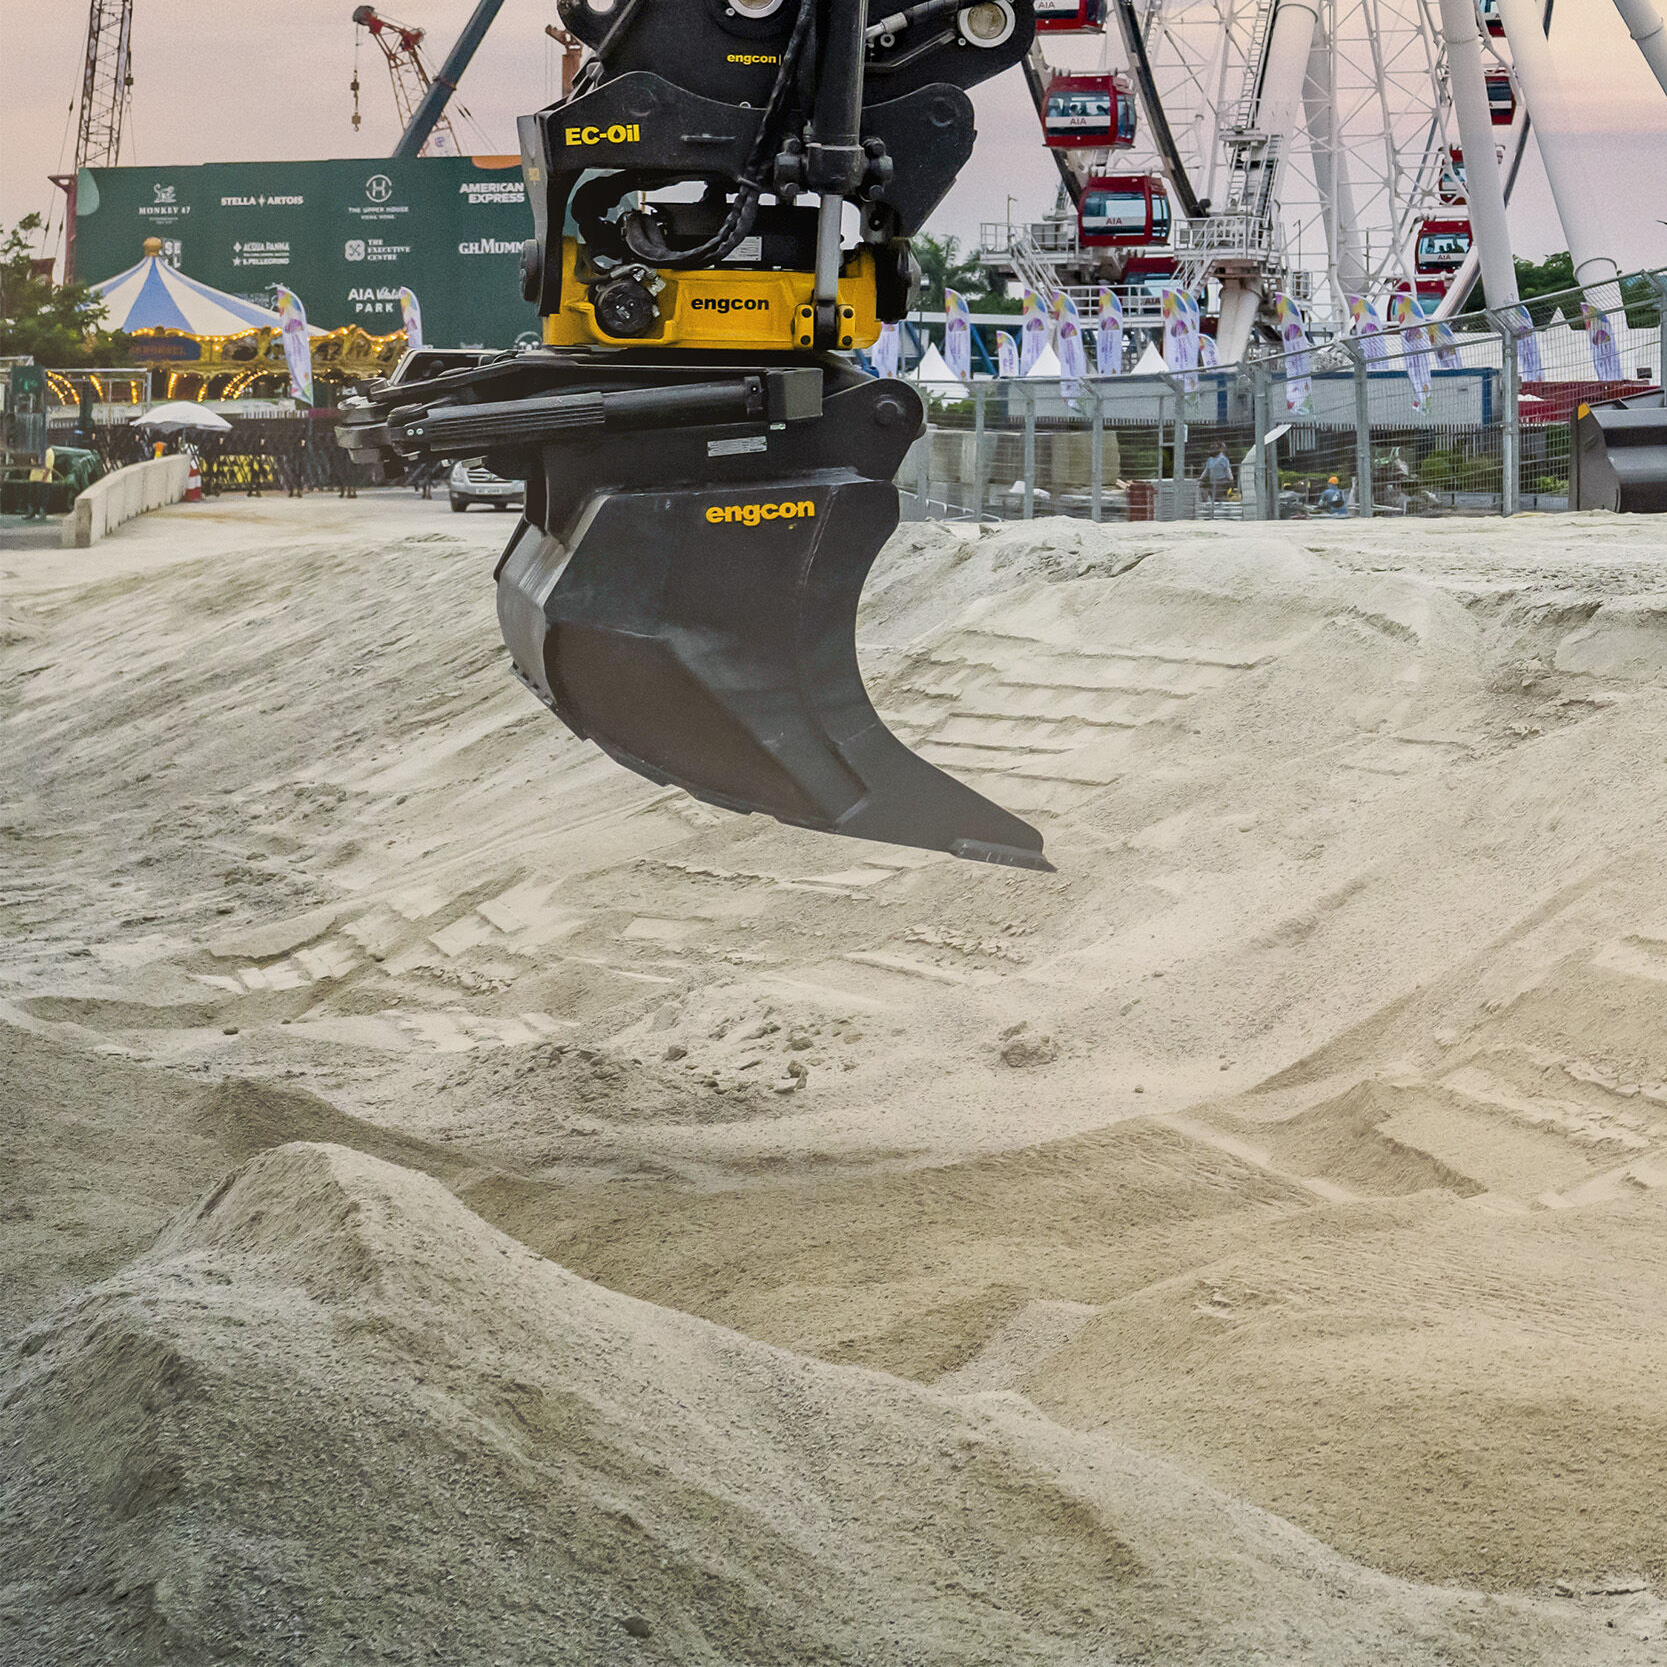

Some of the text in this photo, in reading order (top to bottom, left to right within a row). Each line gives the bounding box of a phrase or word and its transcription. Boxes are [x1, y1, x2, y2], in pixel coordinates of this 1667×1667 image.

[1038, 1, 1055, 9] AIA
[727, 53, 777, 65] engcon
[565, 124, 640, 146] EC-Oil
[459, 183, 524, 194] AMERICAN
[220, 196, 304, 206] STELLA ARTOIS
[468, 193, 525, 204] EXPRESS
[138, 206, 179, 215] MONKEY
[367, 246, 411, 254] EXECUTIVE
[348, 288, 375, 301] AIA
[355, 303, 394, 313] PARK
[691, 297, 769, 314] engcon
[705, 500, 815, 527] engcon
